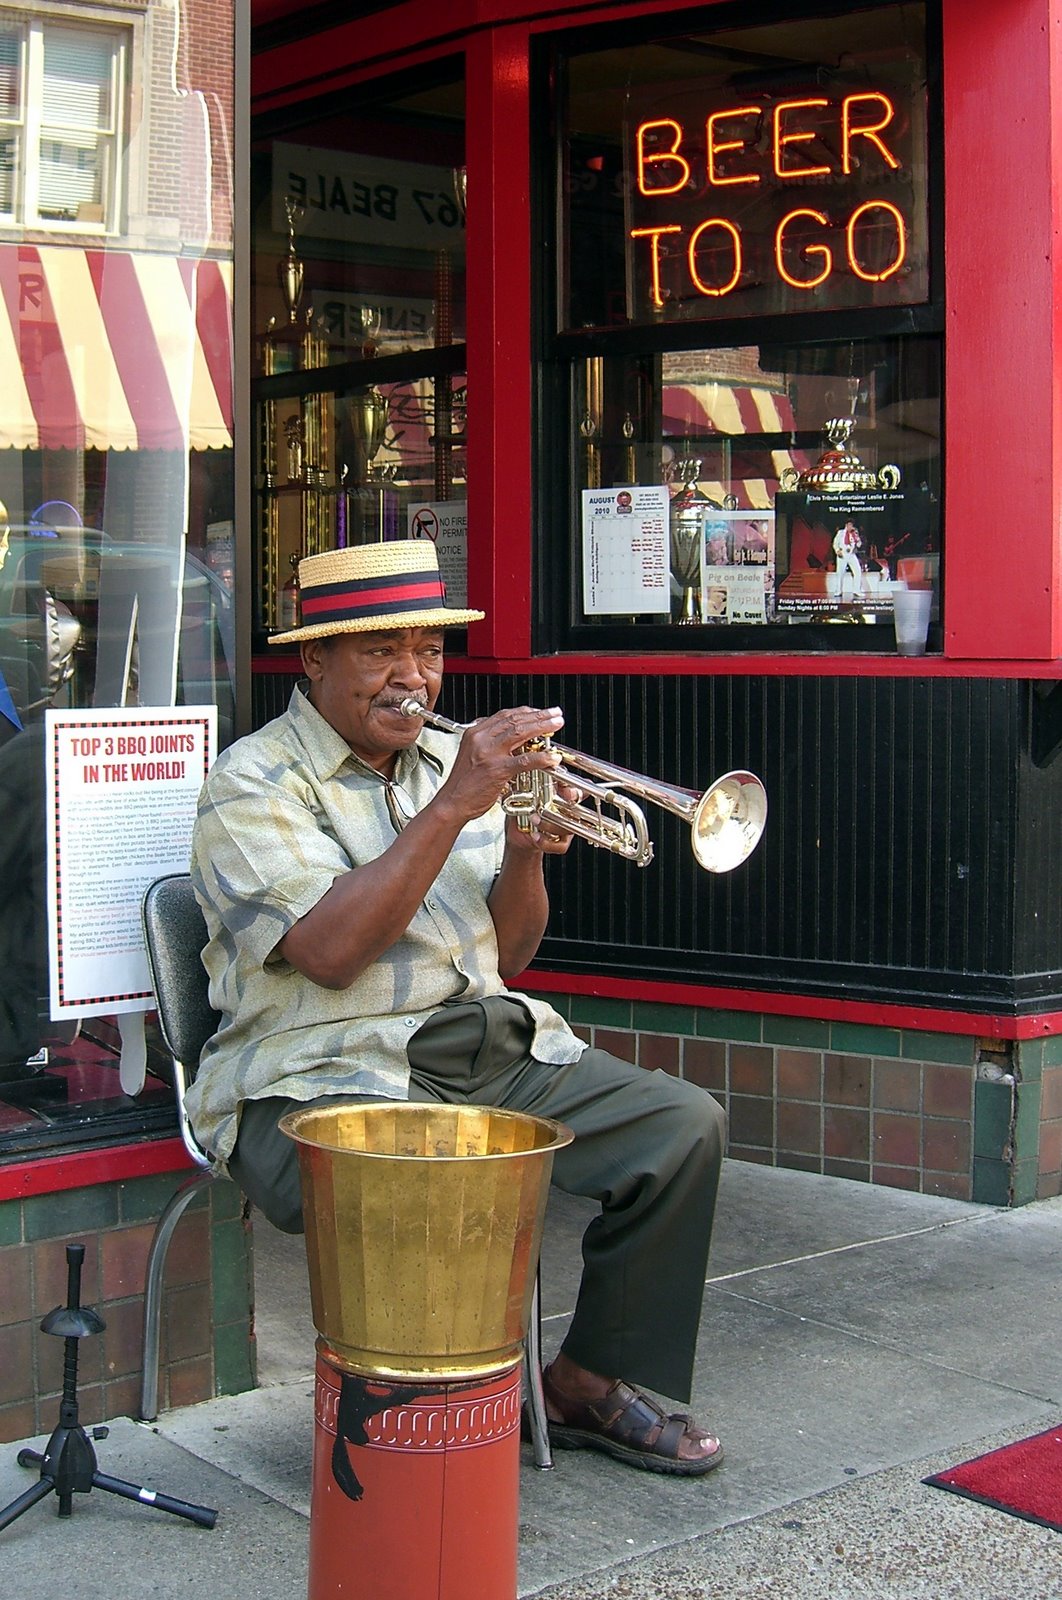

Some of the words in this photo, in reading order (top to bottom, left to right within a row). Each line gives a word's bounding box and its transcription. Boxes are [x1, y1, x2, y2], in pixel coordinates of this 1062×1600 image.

[635, 91, 901, 197] BEER
[630, 216, 742, 307] TO
[774, 199, 908, 290] GO
[589, 496, 616, 504] AUGUST
[840, 493, 866, 501] Entertainer
[595, 507, 611, 515] 2010
[439, 516, 450, 527] NO
[708, 573, 722, 584] Pig
[737, 573, 761, 582] Beale
[732, 611, 741, 619] No
[744, 611, 762, 619] Cover
[71, 737, 101, 756] TOP
[105, 737, 115, 756] 3
[117, 736, 147, 756] BBQ
[149, 734, 195, 754] JOINTS
[83, 765, 99, 783] IN
[102, 763, 129, 782] THE
[131, 761, 185, 781] WORLD!
